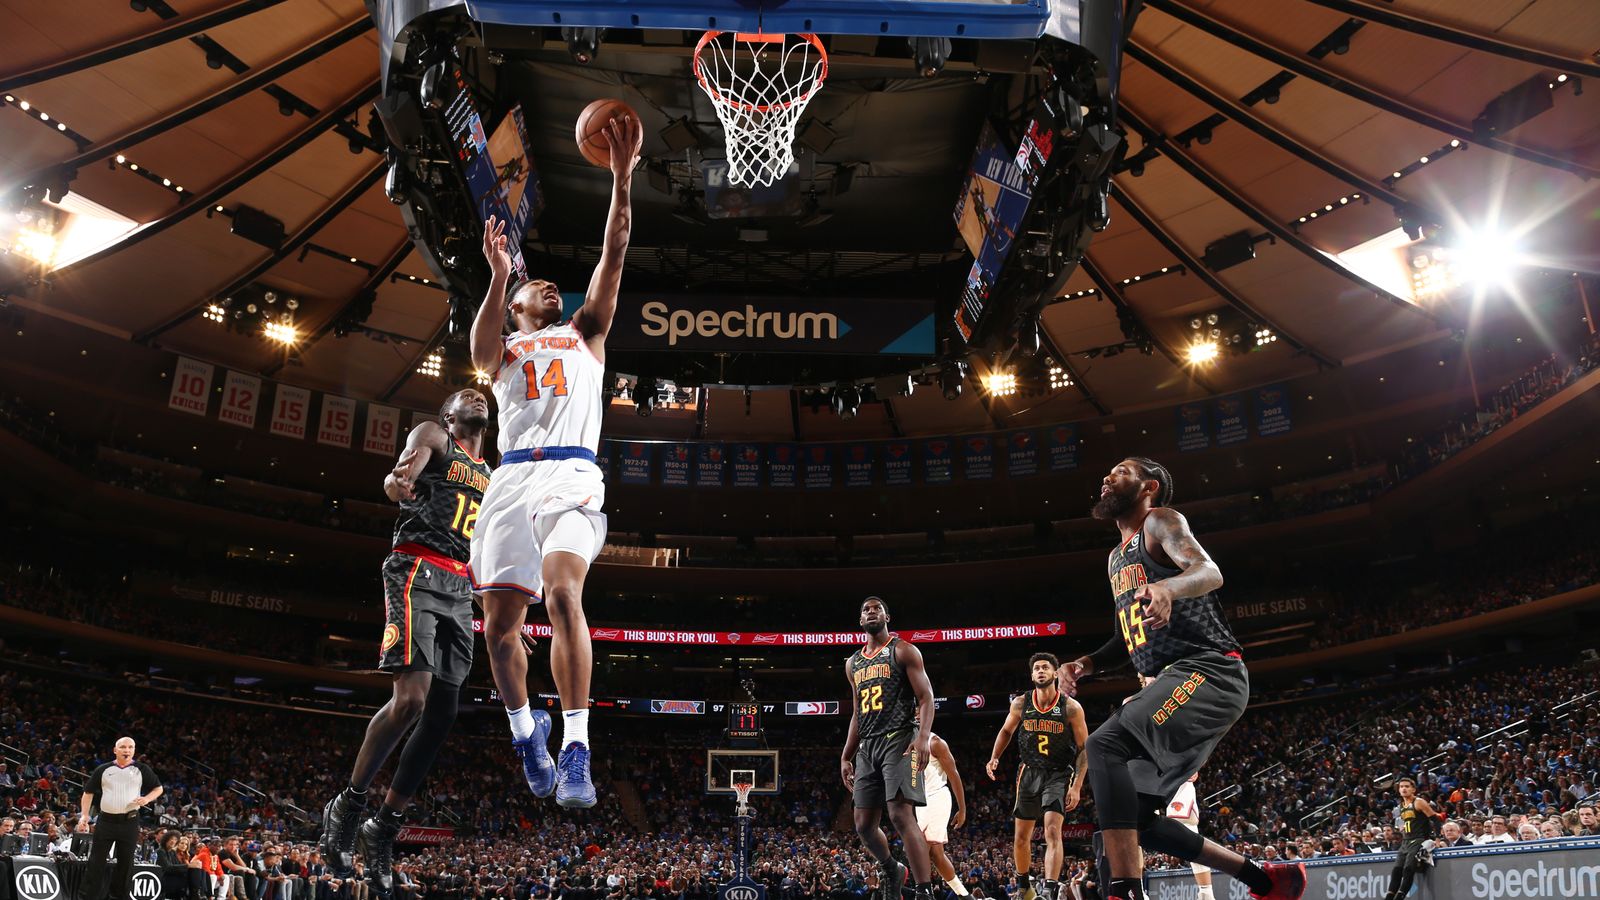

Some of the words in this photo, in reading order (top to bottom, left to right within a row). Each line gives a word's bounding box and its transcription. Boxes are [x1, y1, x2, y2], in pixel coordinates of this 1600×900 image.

[641, 301, 838, 345] Spectrum
[511, 340, 535, 357] EW
[536, 337, 581, 352] YORK
[178, 373, 205, 397] 10
[522, 358, 568, 401] 14
[170, 395, 206, 412] KNICKS
[227, 387, 252, 410] 12
[221, 408, 254, 425] KNICKS
[278, 399, 303, 422] 15
[325, 409, 349, 431] 15
[273, 421, 304, 435] KNICKS
[319, 431, 350, 444] KNICKS
[370, 418, 393, 440] 19
[365, 439, 394, 453] KNICKS
[664, 461, 688, 469] 1950-51
[450, 492, 481, 540] 12
[210, 589, 243, 607] BLUE
[246, 594, 284, 613] SEATS
[1236, 602, 1267, 618] BLUE
[1271, 598, 1307, 614] SEATS
[623, 630, 645, 641] THIS
[646, 631, 675, 642] BUD'S
[677, 632, 695, 643] FOR
[697, 633, 718, 643] YOU.
[941, 630, 963, 640] THIS
[964, 628, 994, 639] BUD'S
[995, 627, 1014, 638] FOR
[1015, 625, 1038, 636] YOU.
[1118, 601, 1148, 653] 95
[783, 634, 803, 644] THIS
[805, 633, 833, 644] BUD'S
[835, 633, 855, 643] FOR
[546, 698, 553, 706] 9
[712, 704, 725, 712] 97
[860, 684, 883, 714] 22
[1152, 671, 1206, 726] HAWKS
[763, 705, 775, 713] 77
[740, 714, 754, 729] 17
[1023, 719, 1064, 734] ATLANTA
[1038, 734, 1049, 756] 2
[23, 873, 54, 894] KIA
[133, 878, 156, 897] KIA
[1471, 860, 1600, 900] Spectrum
[730, 890, 753, 900] KIA
